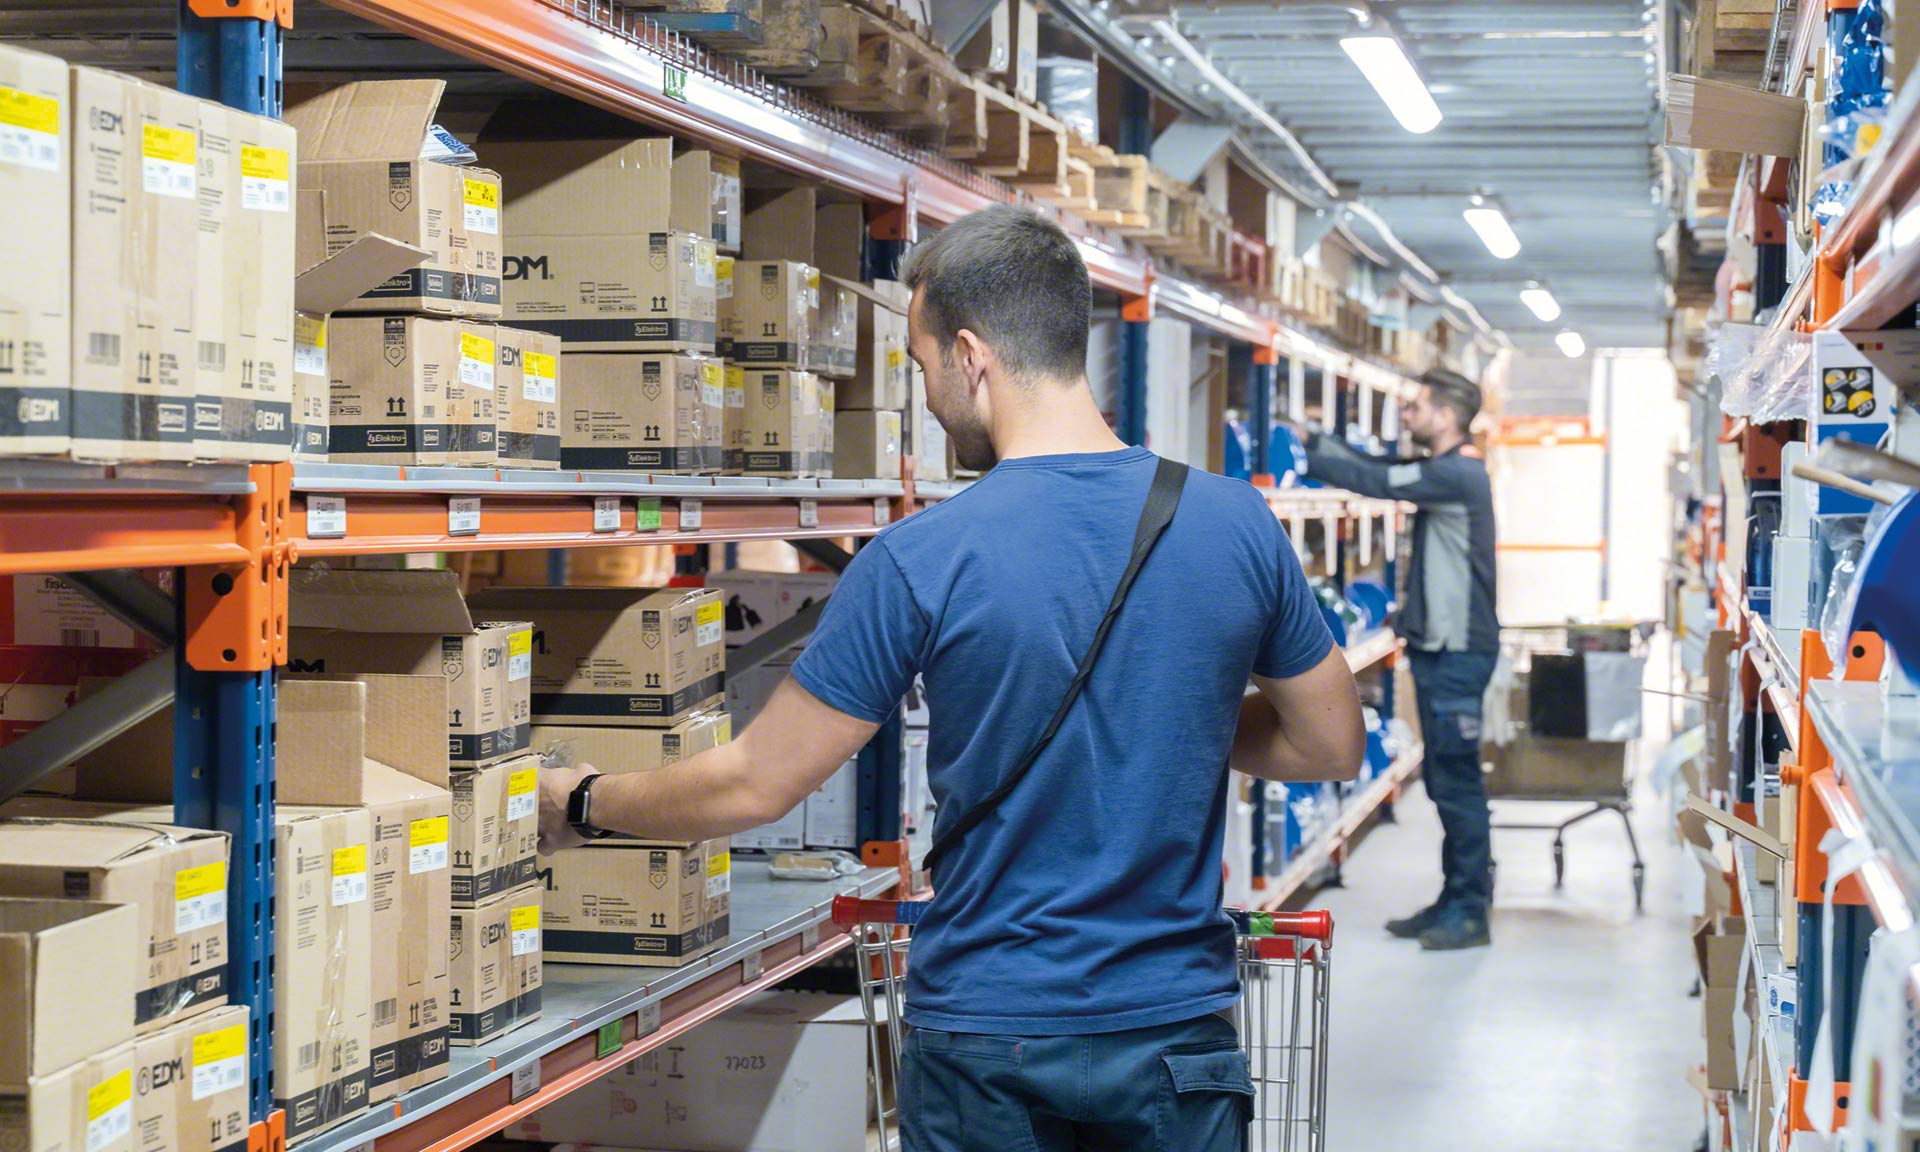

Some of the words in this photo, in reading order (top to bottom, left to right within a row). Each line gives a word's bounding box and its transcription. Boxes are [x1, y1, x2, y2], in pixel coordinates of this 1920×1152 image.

[99, 109, 125, 135] EDM
[502, 255, 549, 281] DM
[502, 345, 523, 368] EDM
[29, 398, 60, 422] EDM
[264, 411, 284, 431] EDM
[489, 921, 507, 945] EDM
[203, 973, 220, 993] EDM
[428, 1036, 446, 1056] EDM
[153, 1056, 185, 1090] EDM
[350, 1079, 366, 1101] EDM
